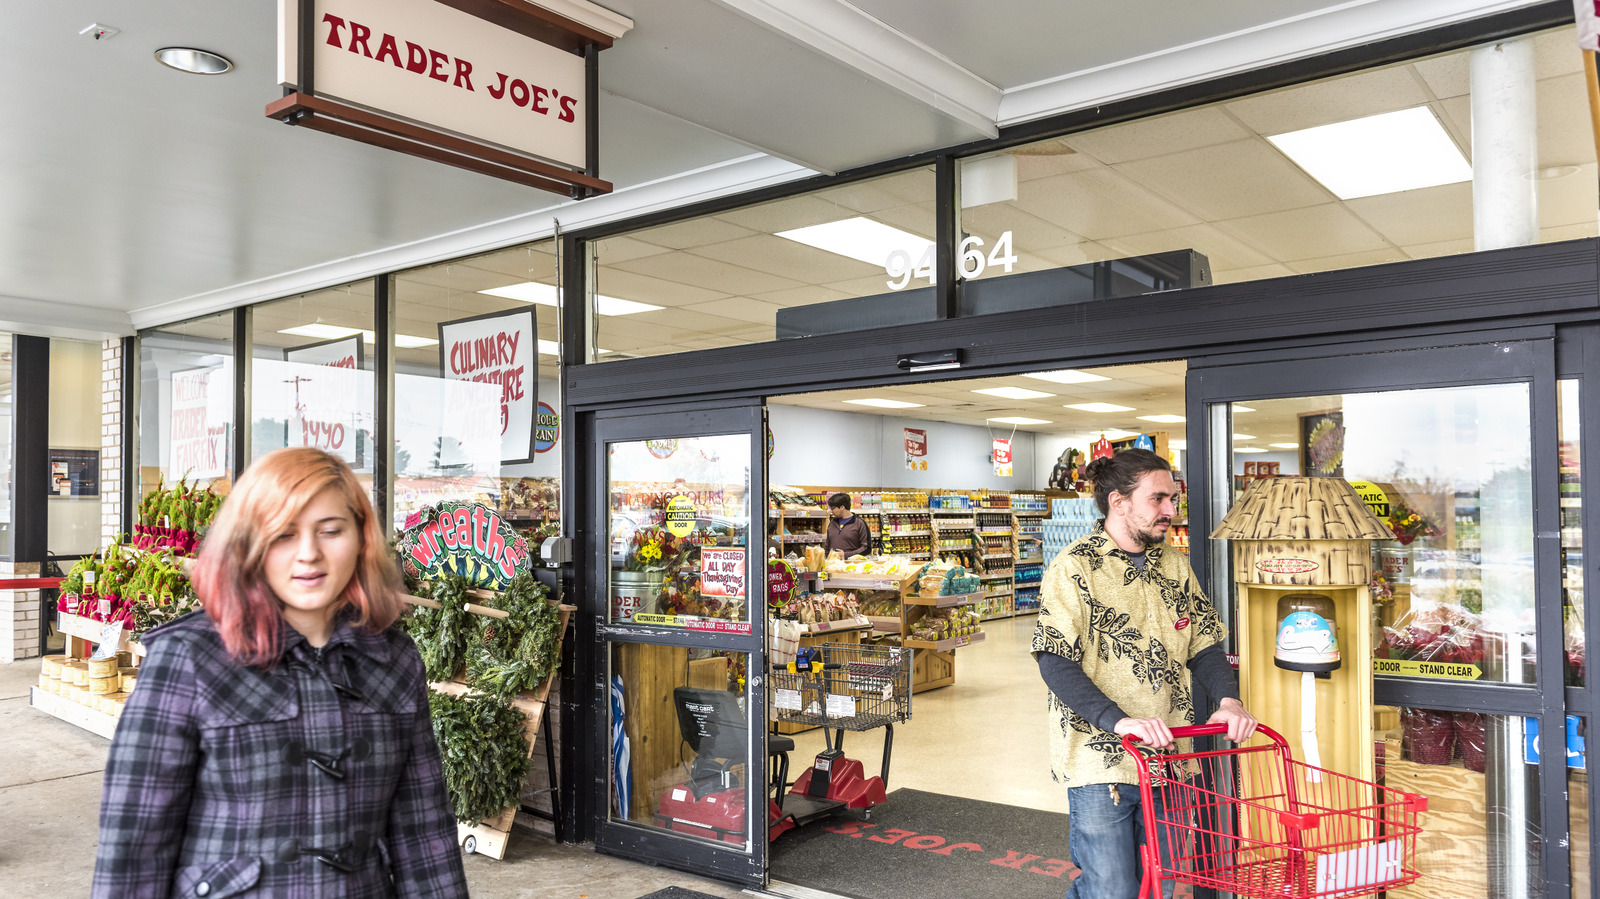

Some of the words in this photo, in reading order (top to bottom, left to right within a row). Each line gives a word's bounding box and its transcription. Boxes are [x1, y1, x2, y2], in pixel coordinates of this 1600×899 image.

[322, 13, 475, 92] TRADER
[487, 72, 578, 123] JOE'S
[450, 330, 520, 375] CULINARY
[536, 429, 555, 442] RAIN
[411, 506, 520, 580] wreaths
[723, 552, 744, 561] CLOSED
[708, 562, 719, 572] ALL
[722, 562, 736, 573] DAY
[702, 571, 743, 588] Thanksgiving
[726, 585, 739, 597] Day
[772, 582, 788, 593] BAGS
[724, 623, 737, 631] STAND
[737, 624, 750, 632] CLEAR
[1380, 661, 1401, 672] DOOR
[1420, 664, 1445, 675] STAND
[1447, 665, 1473, 677] CLEAR
[822, 821, 984, 856] JOE'S
